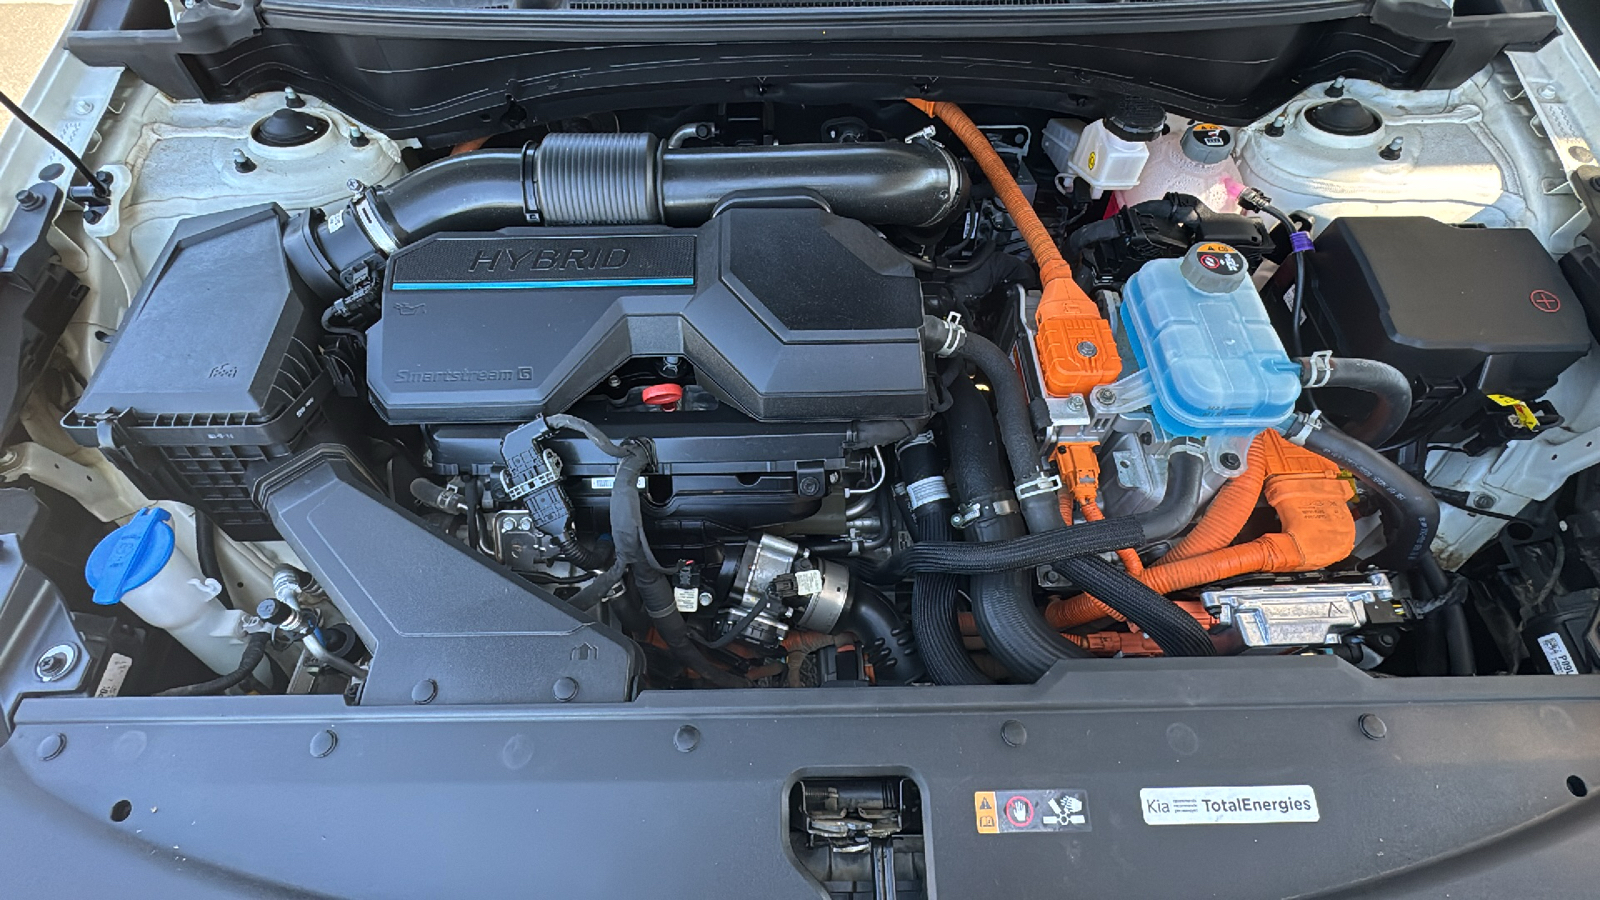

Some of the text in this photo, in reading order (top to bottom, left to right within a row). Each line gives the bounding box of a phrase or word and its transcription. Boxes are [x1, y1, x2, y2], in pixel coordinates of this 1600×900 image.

[468, 249, 631, 272] HYBRID
[394, 368, 513, 384] Smartstream
[1146, 797, 1312, 814] Kia TotalEnergies
